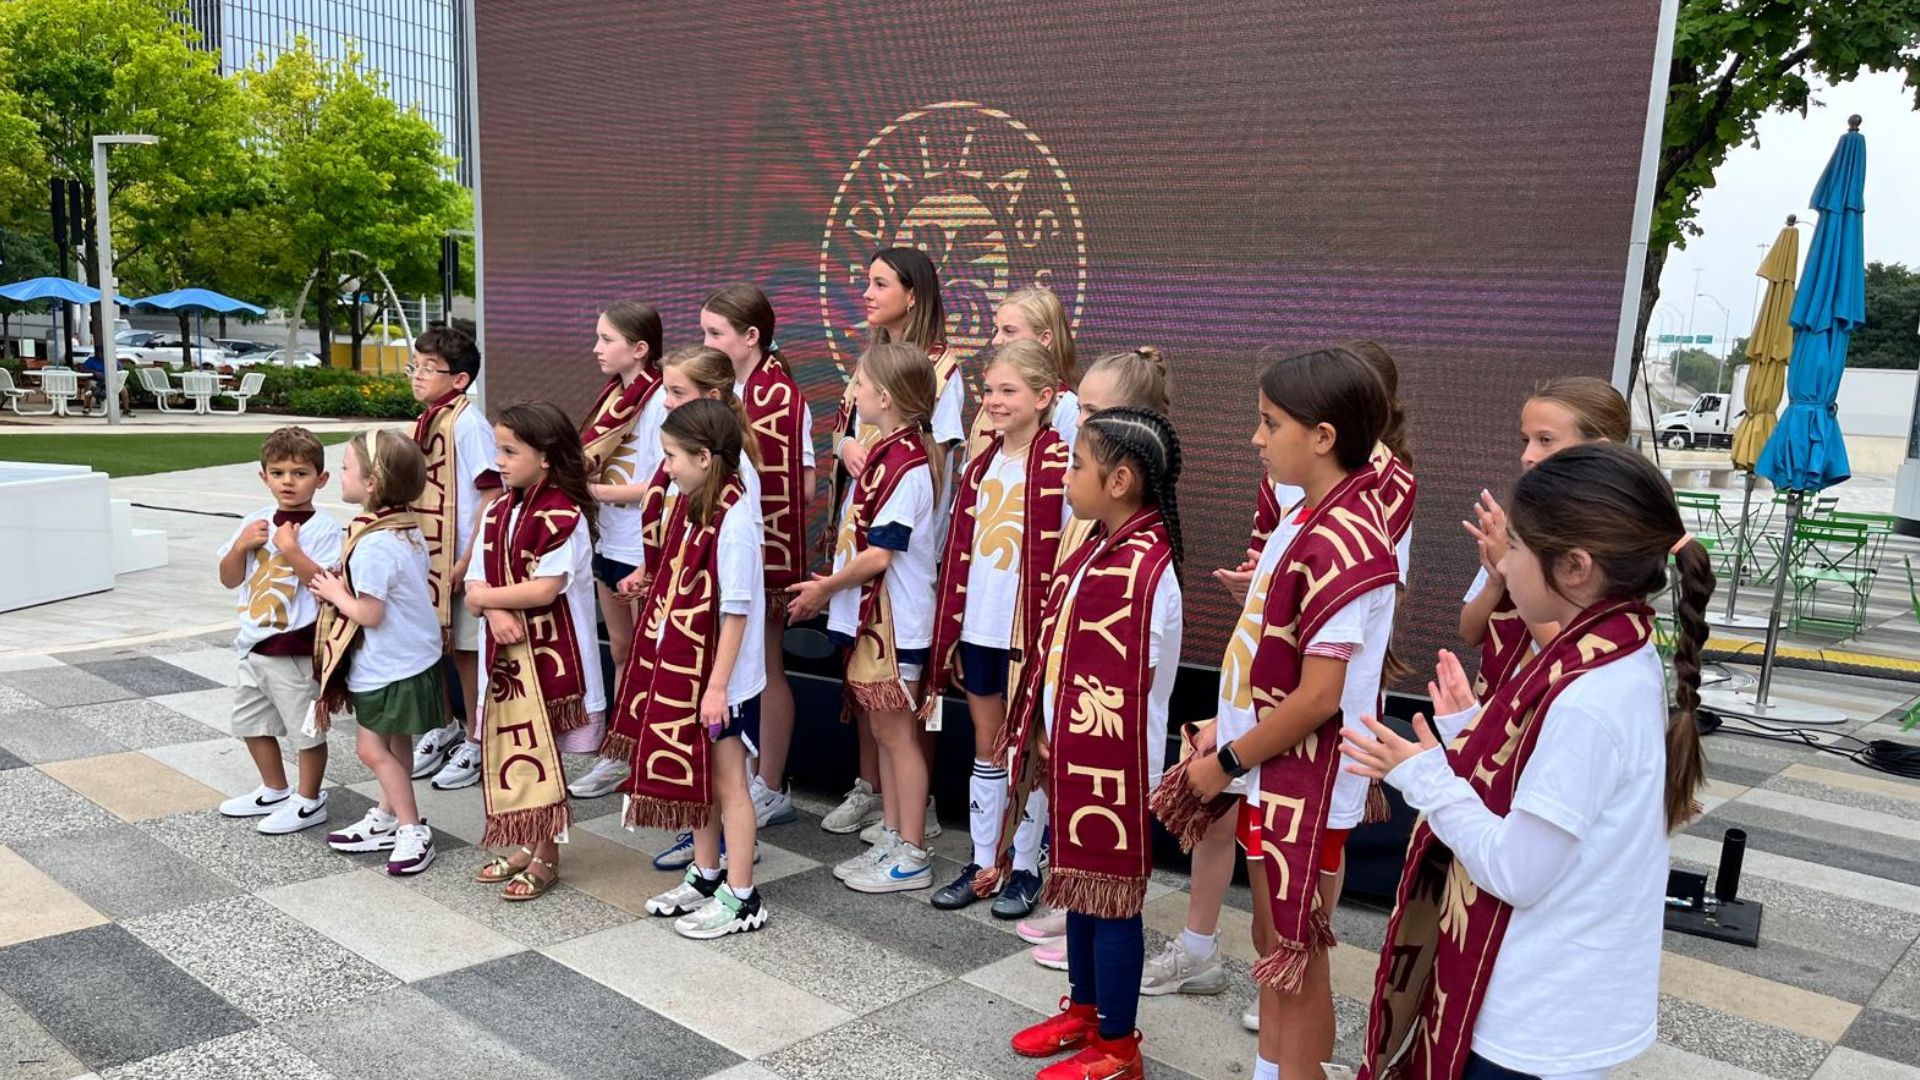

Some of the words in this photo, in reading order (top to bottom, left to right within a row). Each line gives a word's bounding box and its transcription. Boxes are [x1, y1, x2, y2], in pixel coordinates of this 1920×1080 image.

[751, 381, 792, 572] DALLAS
[646, 565, 712, 787] DALLAS
[496, 719, 546, 790] FC
[1067, 761, 1128, 850] FC
